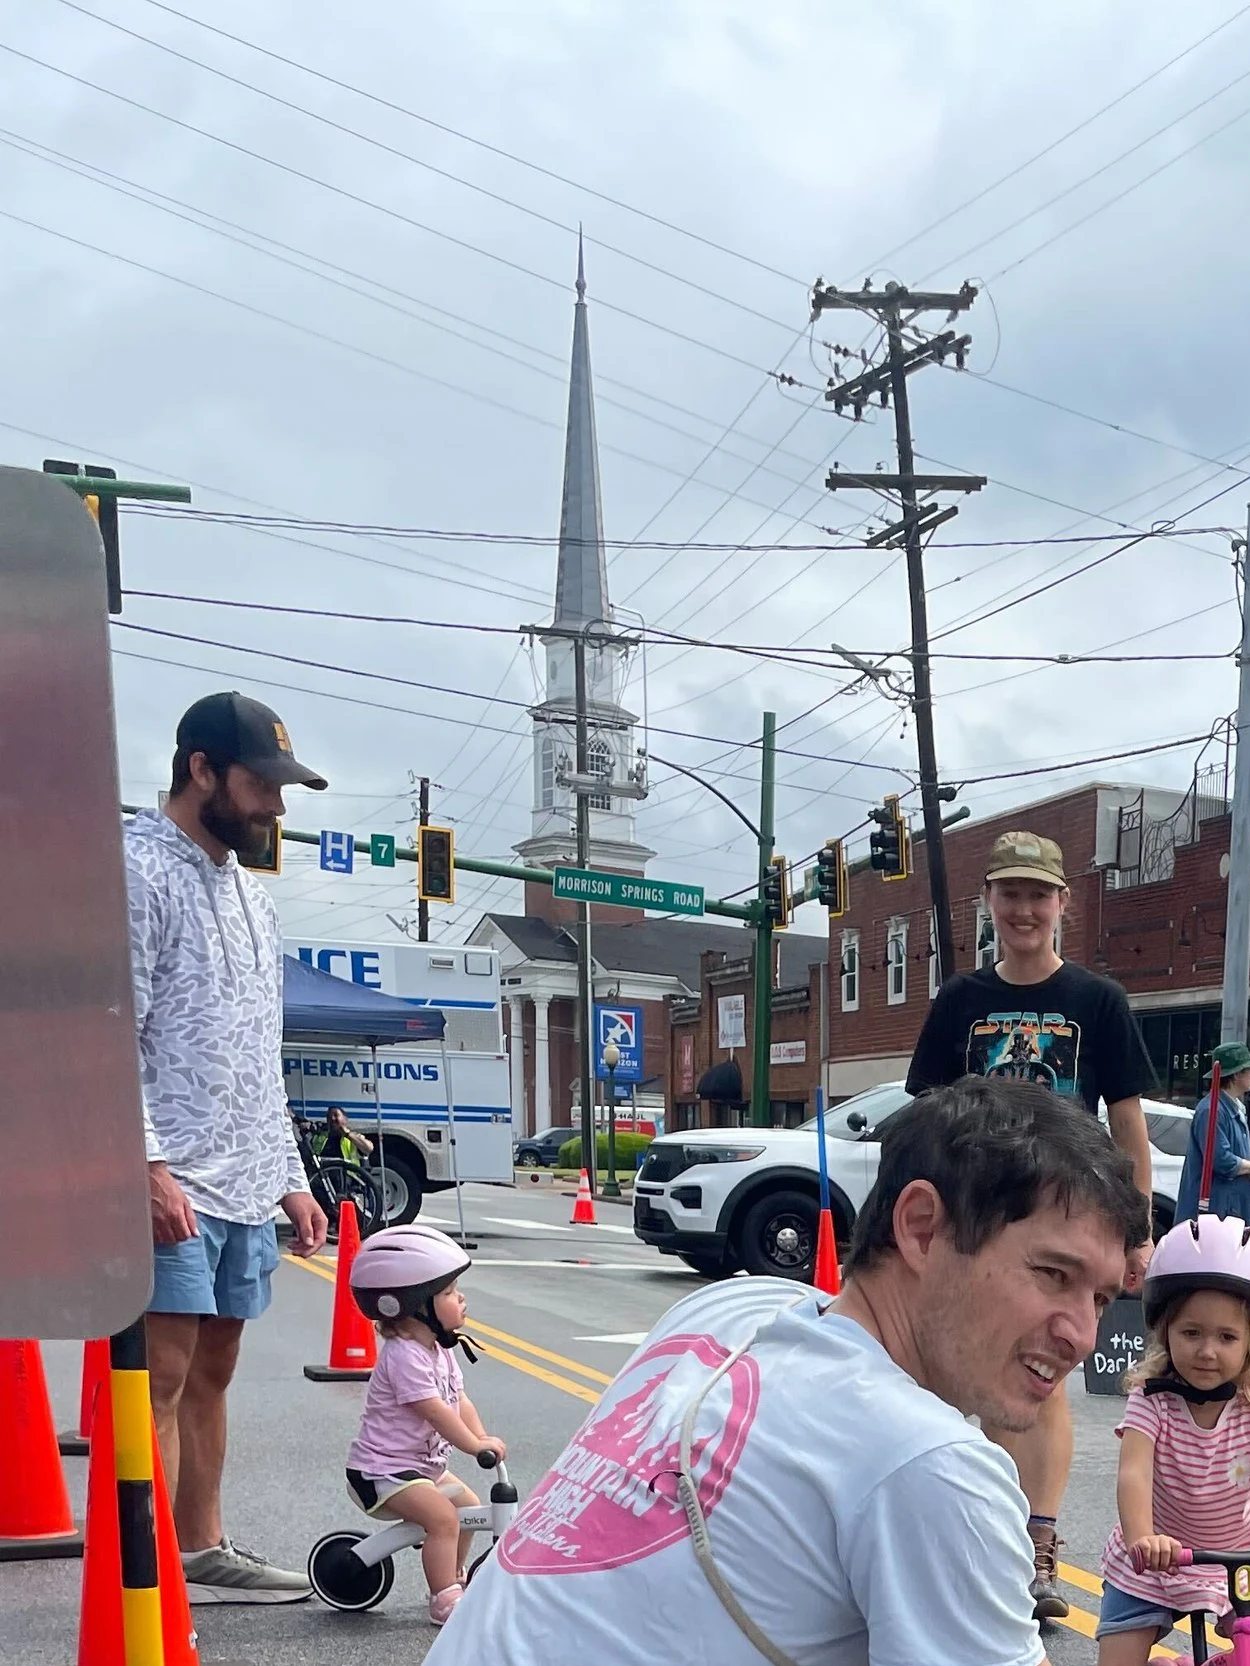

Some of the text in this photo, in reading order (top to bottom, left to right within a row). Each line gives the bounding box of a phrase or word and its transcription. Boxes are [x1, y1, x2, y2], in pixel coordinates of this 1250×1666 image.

[378, 843, 389, 859] 7
[558, 875, 701, 908] MORRISON SPRINGS ROAD
[974, 1012, 1073, 1037] STAR
[283, 1057, 439, 1081] PERATIONS
[1110, 1332, 1144, 1351] the
[1094, 1351, 1138, 1375] Dark
[540, 1476, 597, 1524] HIGH
